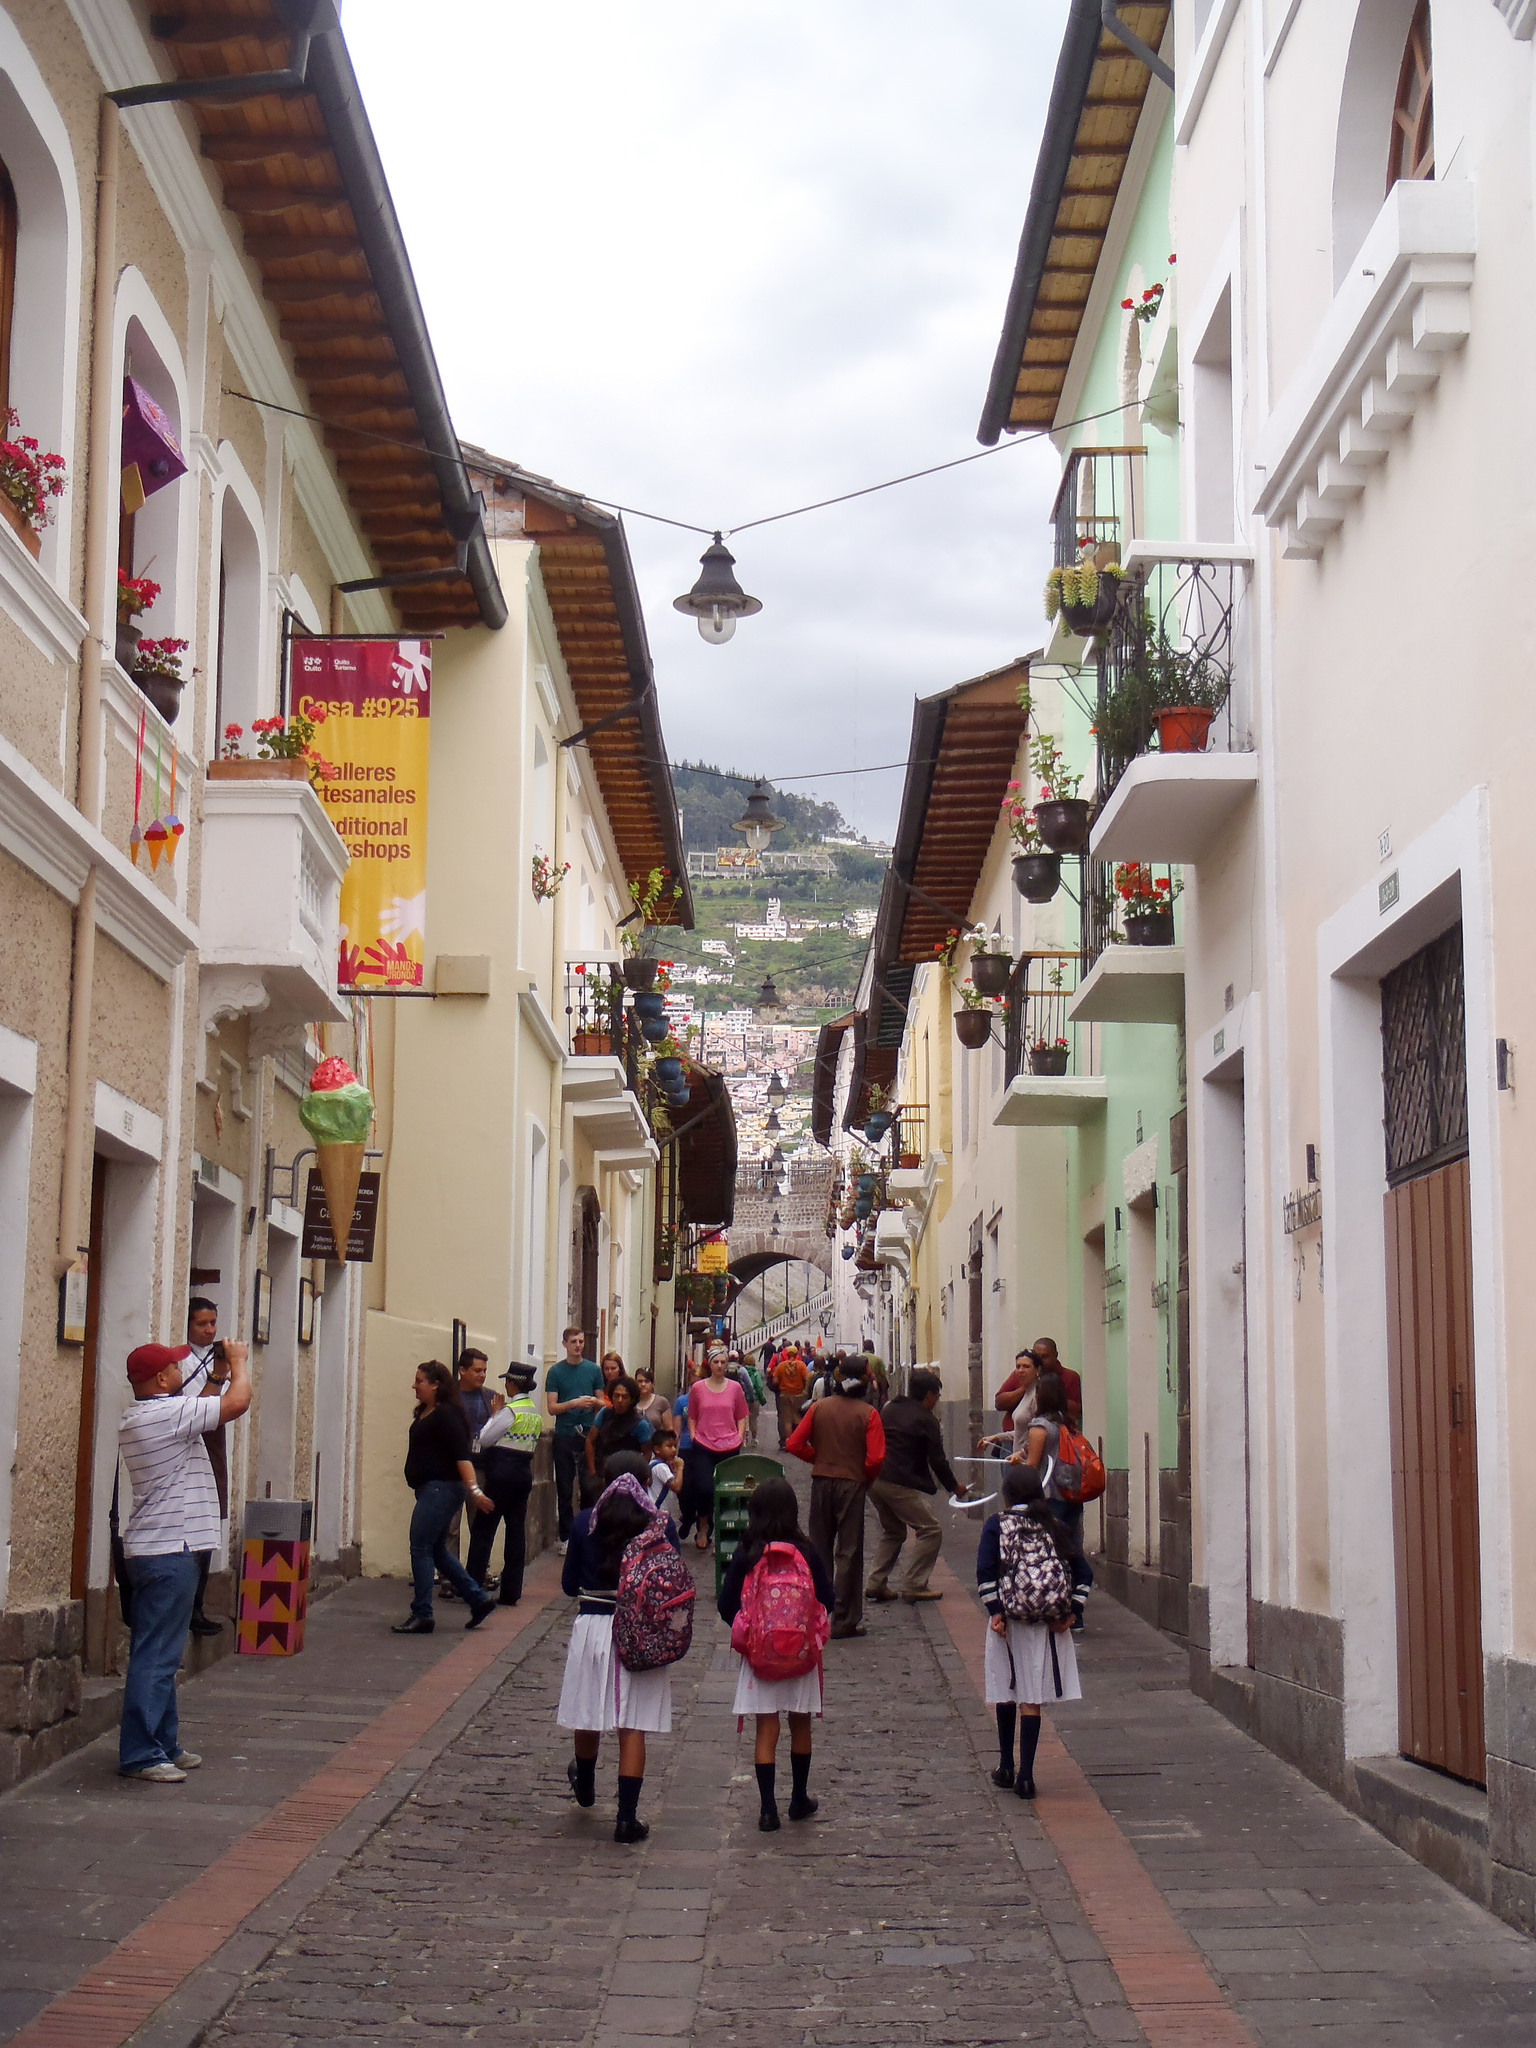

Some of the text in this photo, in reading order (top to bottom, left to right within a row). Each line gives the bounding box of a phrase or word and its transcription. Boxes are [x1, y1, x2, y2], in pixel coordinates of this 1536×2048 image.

[299, 695, 419, 718] Casa #925
[328, 762, 396, 782] alleres
[331, 816, 408, 836] ditional
